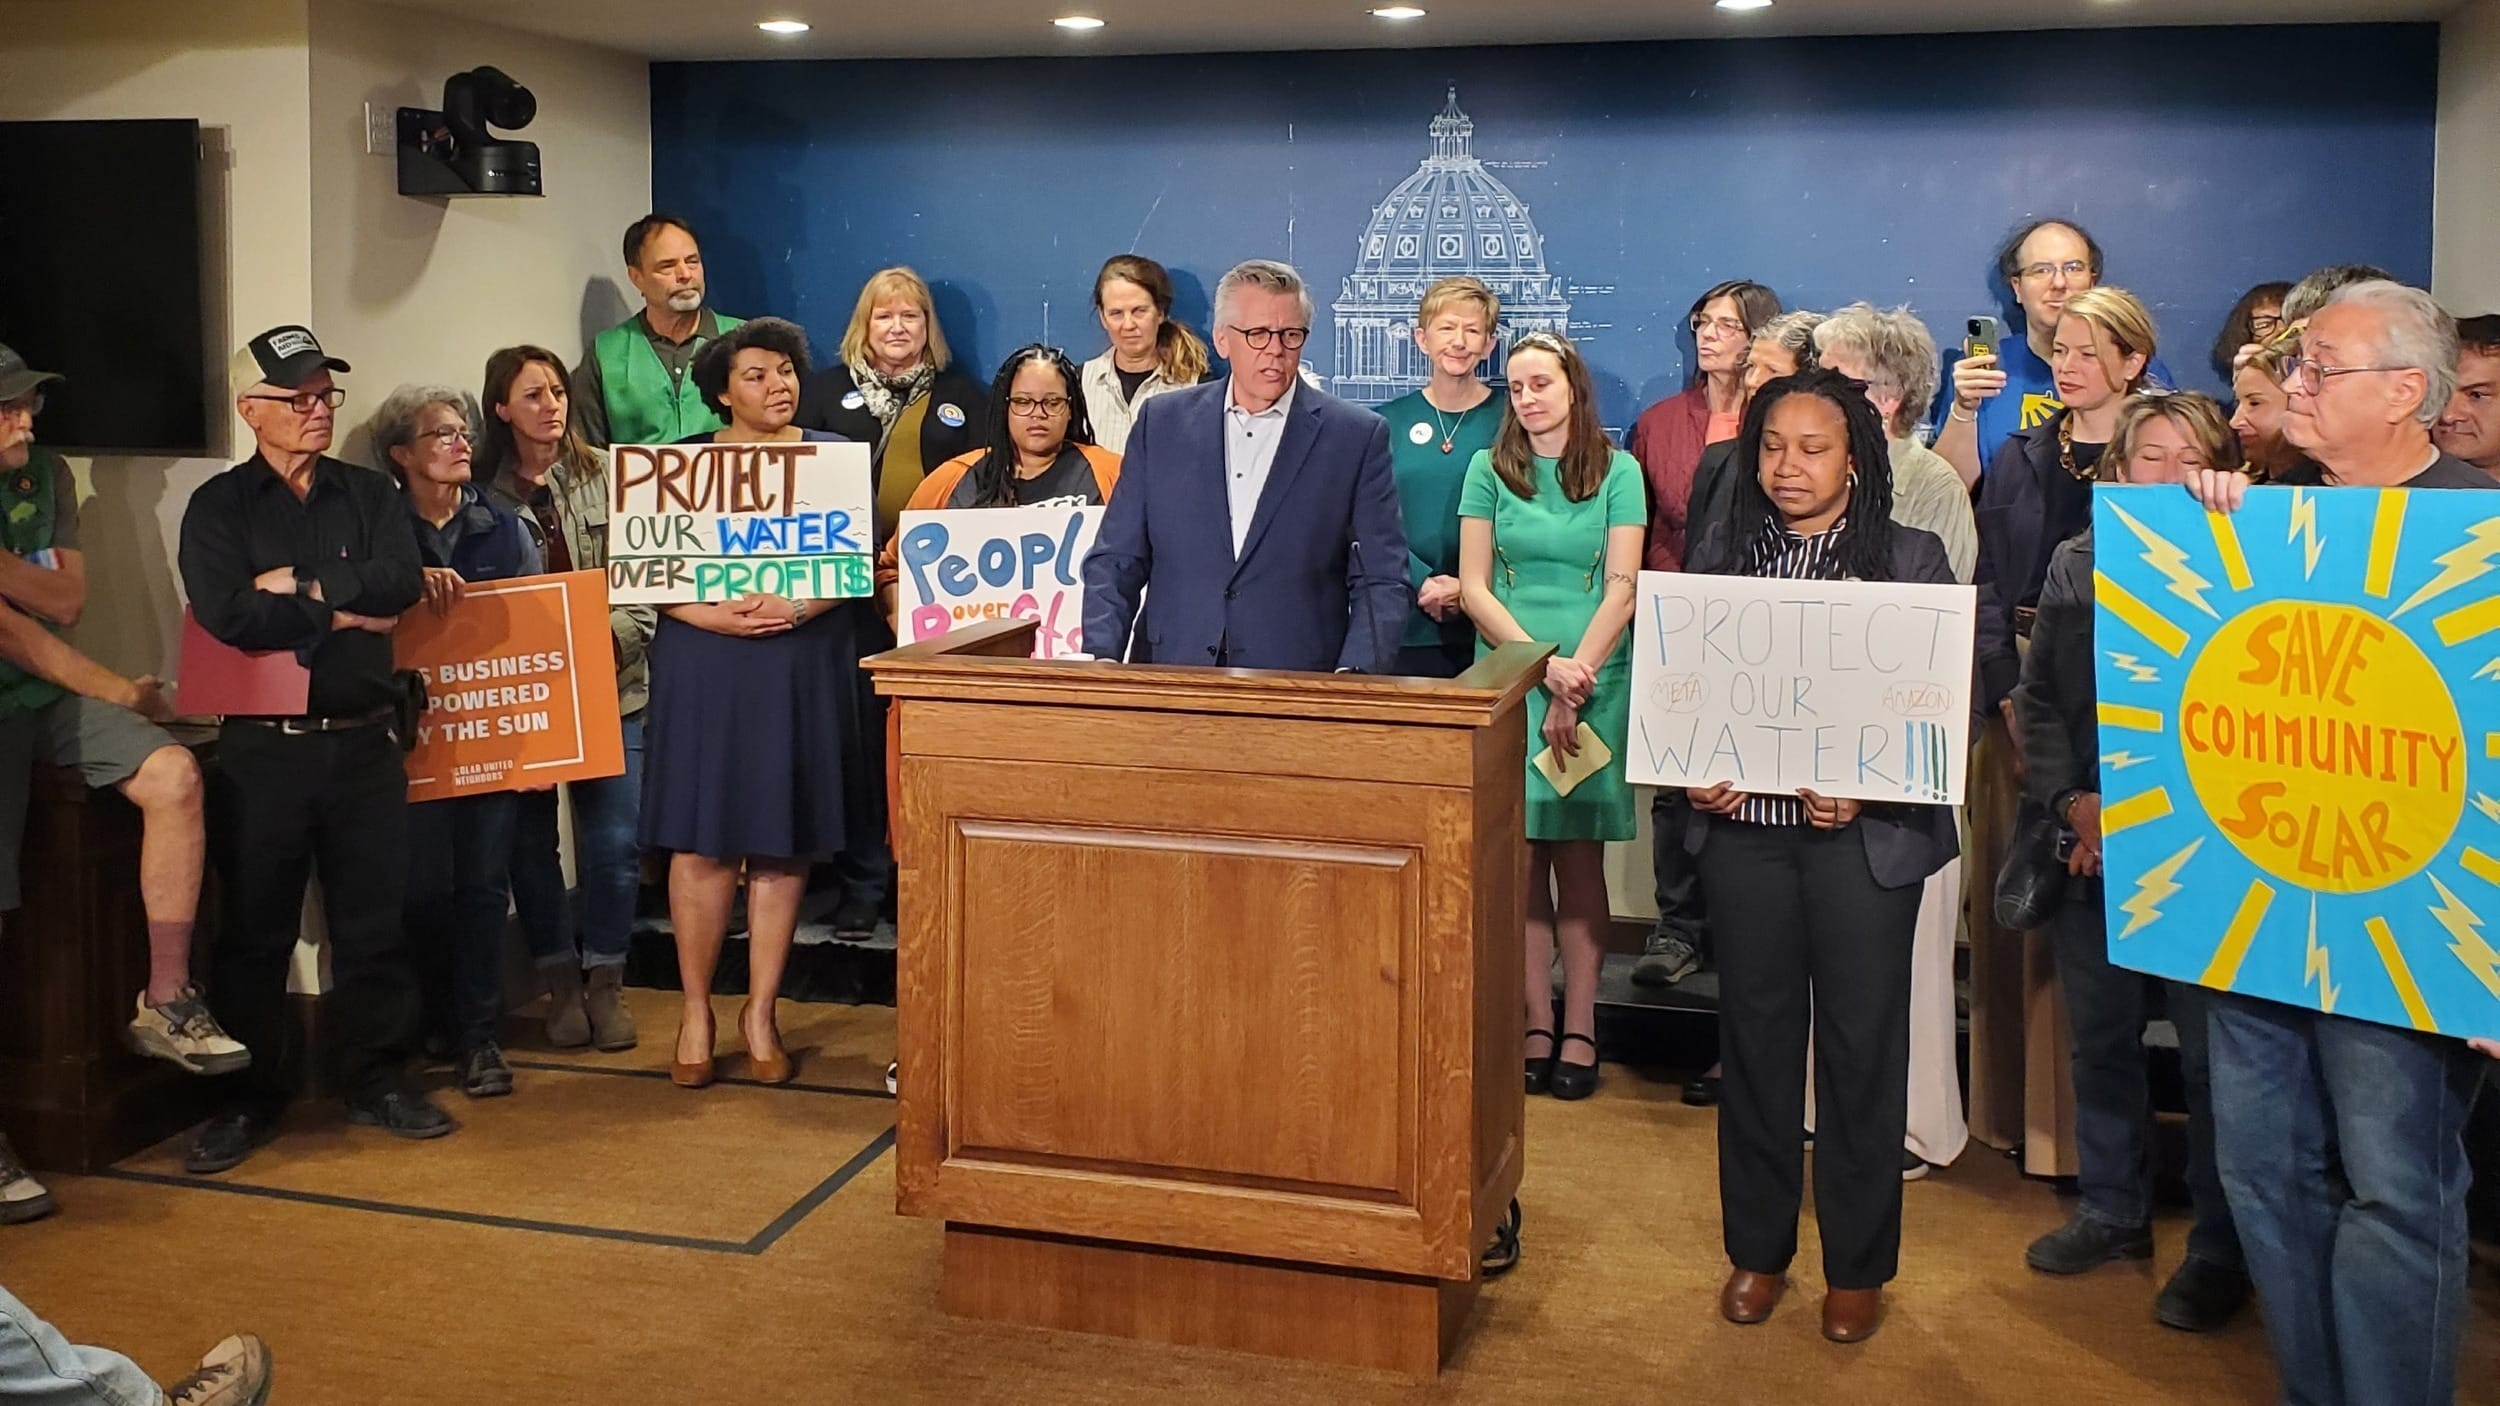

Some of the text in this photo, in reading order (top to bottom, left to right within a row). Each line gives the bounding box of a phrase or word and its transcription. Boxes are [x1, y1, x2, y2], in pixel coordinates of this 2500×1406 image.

[615, 446, 817, 517] PROTECT
[625, 510, 861, 556] OUR WATER
[610, 557, 695, 590] OVER
[1653, 594, 1961, 673] PROTECT
[439, 651, 565, 684] BUSINESS
[2237, 608, 2385, 707] SAVE
[427, 683, 550, 715] POWERED
[1650, 679, 1703, 704] META
[1729, 671, 1817, 719] OUR
[441, 719, 490, 742] THE
[497, 711, 549, 736] SUN
[2183, 701, 2458, 793] COMMUNITY
